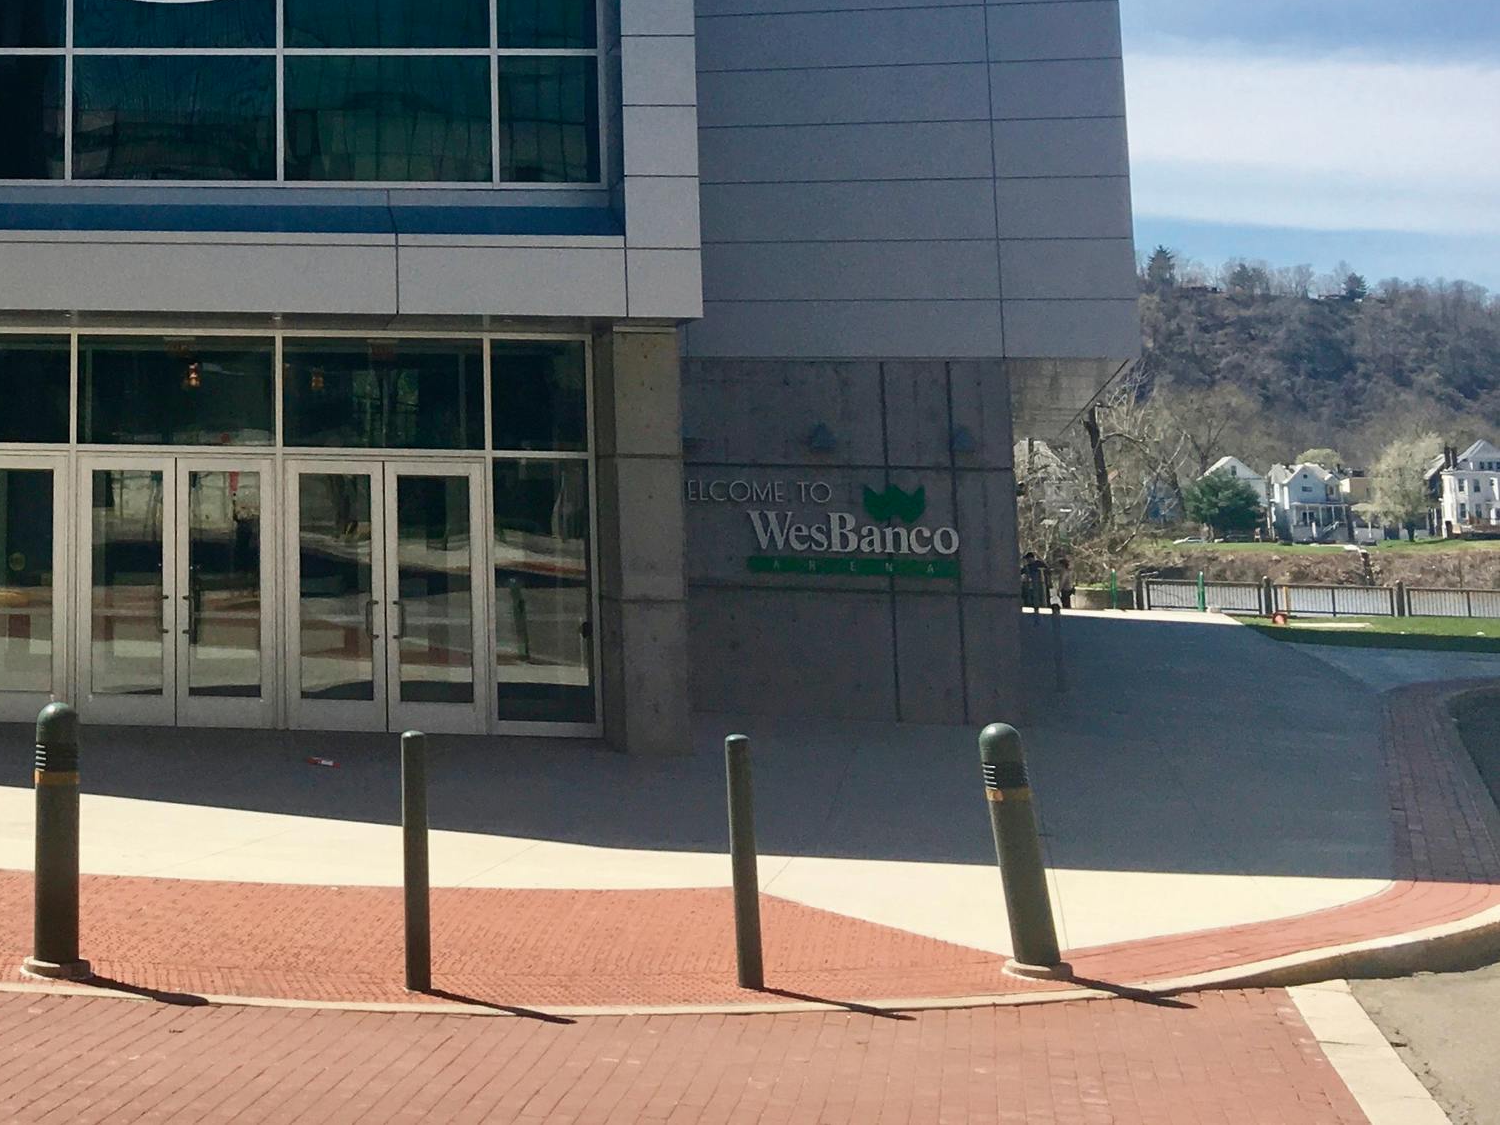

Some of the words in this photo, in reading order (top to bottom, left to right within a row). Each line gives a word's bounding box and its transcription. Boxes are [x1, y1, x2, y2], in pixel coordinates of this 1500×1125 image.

[686, 480, 785, 503] ELCOME
[797, 480, 833, 504] TO
[747, 509, 960, 555] WesBanco
[772, 561, 936, 573] ARENA
